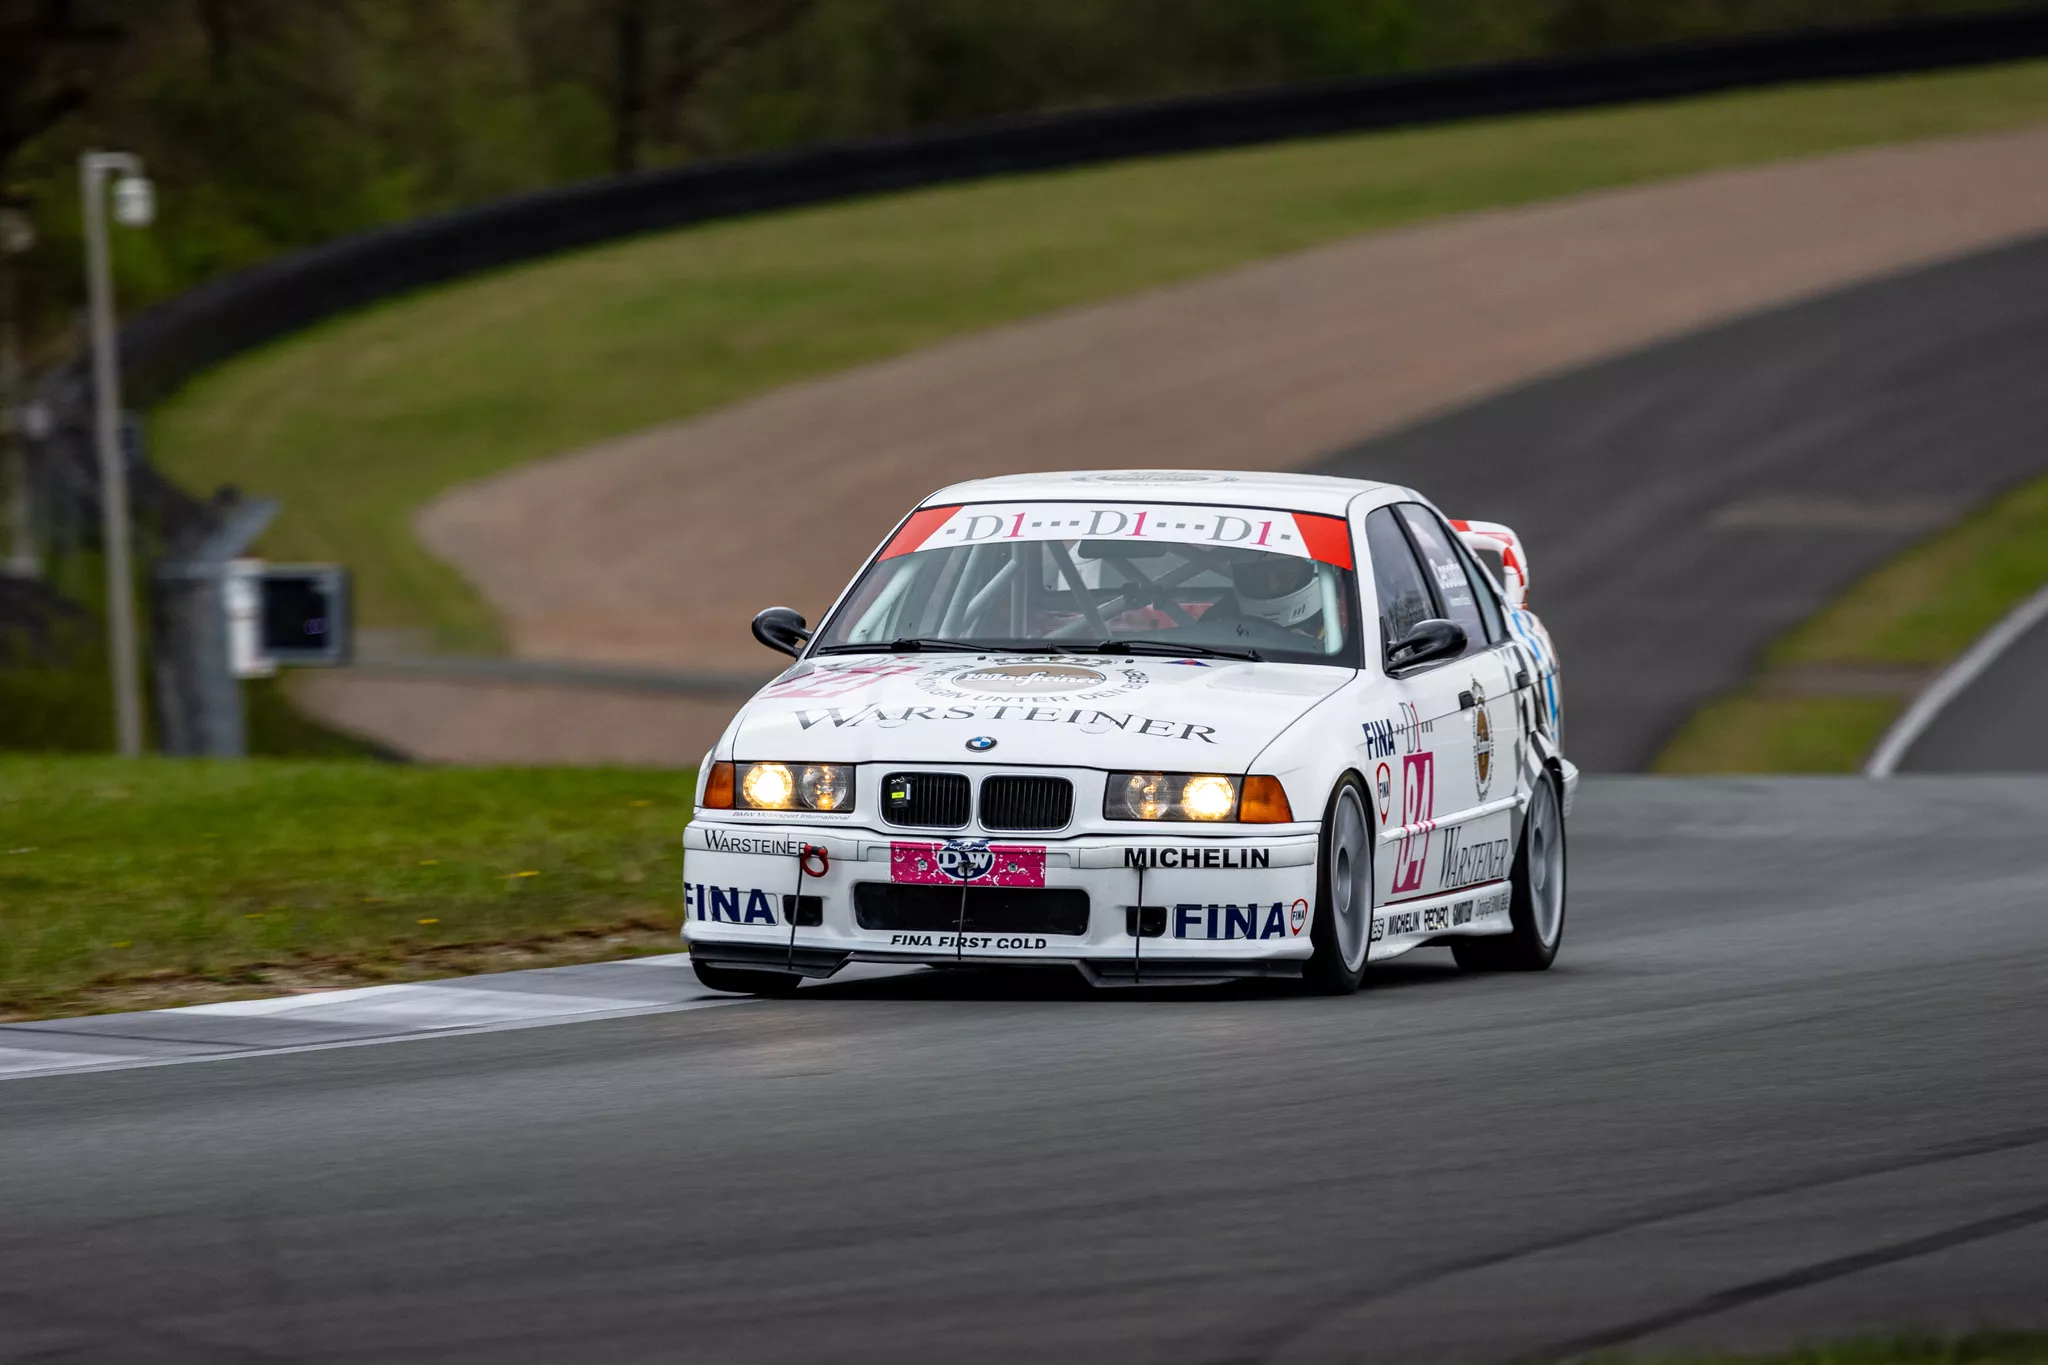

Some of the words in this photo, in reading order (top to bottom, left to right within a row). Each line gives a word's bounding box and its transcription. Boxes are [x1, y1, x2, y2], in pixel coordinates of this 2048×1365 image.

[961, 512, 1025, 541] D1
[1086, 510, 1149, 538] D1
[1206, 515, 1273, 547] D1
[793, 702, 1219, 744] WARSTEINER
[1362, 718, 1396, 760] FINA
[757, 811, 799, 820] Motorsport
[800, 813, 851, 821] International
[1123, 847, 1270, 868] MICHELIN
[1174, 902, 1286, 940] FINA
[1291, 909, 1305, 921] FINA
[1387, 911, 1421, 936] MICHELIN
[1424, 906, 1449, 931] RECARO
[890, 935, 933, 947] FINA
[937, 936, 992, 949] FIRST
[996, 937, 1047, 949] GOLD
